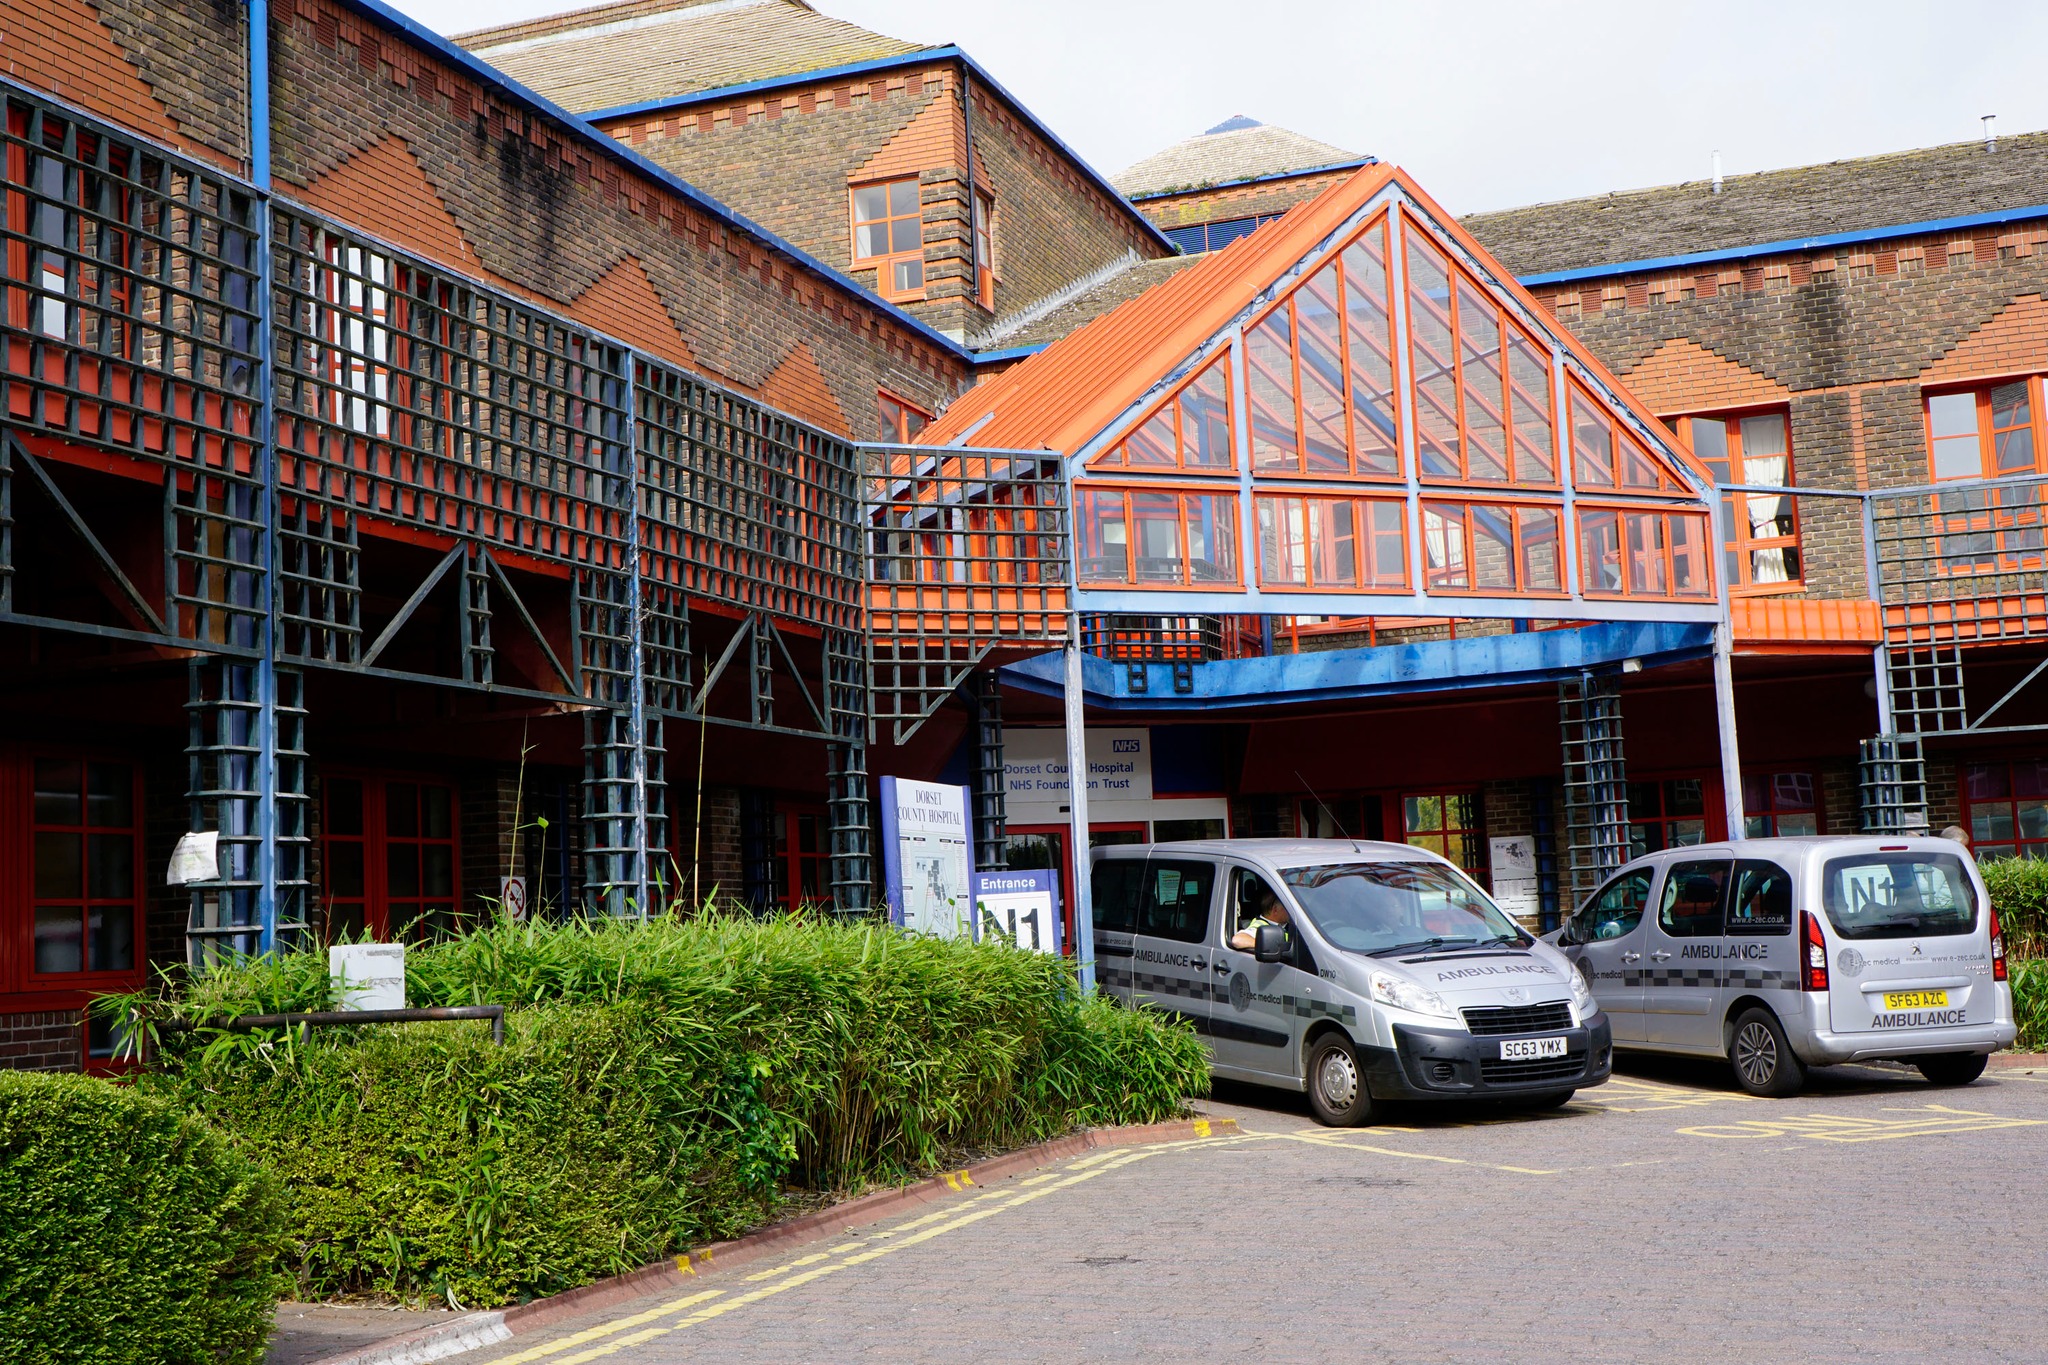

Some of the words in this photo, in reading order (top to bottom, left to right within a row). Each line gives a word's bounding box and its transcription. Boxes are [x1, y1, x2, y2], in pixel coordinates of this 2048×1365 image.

[1114, 741, 1139, 751] NHS
[1004, 764, 1041, 774] Dorset
[1090, 762, 1133, 774] Hospital
[1010, 780, 1032, 790] NHS
[1036, 778, 1098, 790] Foundon
[1103, 779, 1130, 788] Trust
[915, 789, 942, 806] DORSET
[898, 806, 926, 822] COUNTY
[929, 809, 961, 825] HOSPITAL
[981, 878, 1036, 890] Entrance
[1850, 876, 1893, 913] N1
[1731, 914, 1785, 924] www.e-zec.co.uk
[981, 908, 1040, 950] N1
[1134, 948, 1189, 967] AMBULANCE
[1681, 944, 1768, 960] AMBULANCE
[1930, 953, 1986, 962] www.e-zec.co.uk
[1873, 957, 1900, 965] medical
[1437, 964, 1556, 982] AMBULANCE
[1600, 969, 1623, 979] medical
[1257, 993, 1283, 1005] medical
[1889, 993, 1920, 1007] SF63
[1923, 992, 1944, 1006] AZC
[1871, 1009, 1966, 1029] AMBULANCE
[1505, 1041, 1537, 1057] SC63
[1540, 1039, 1562, 1054] YMX
